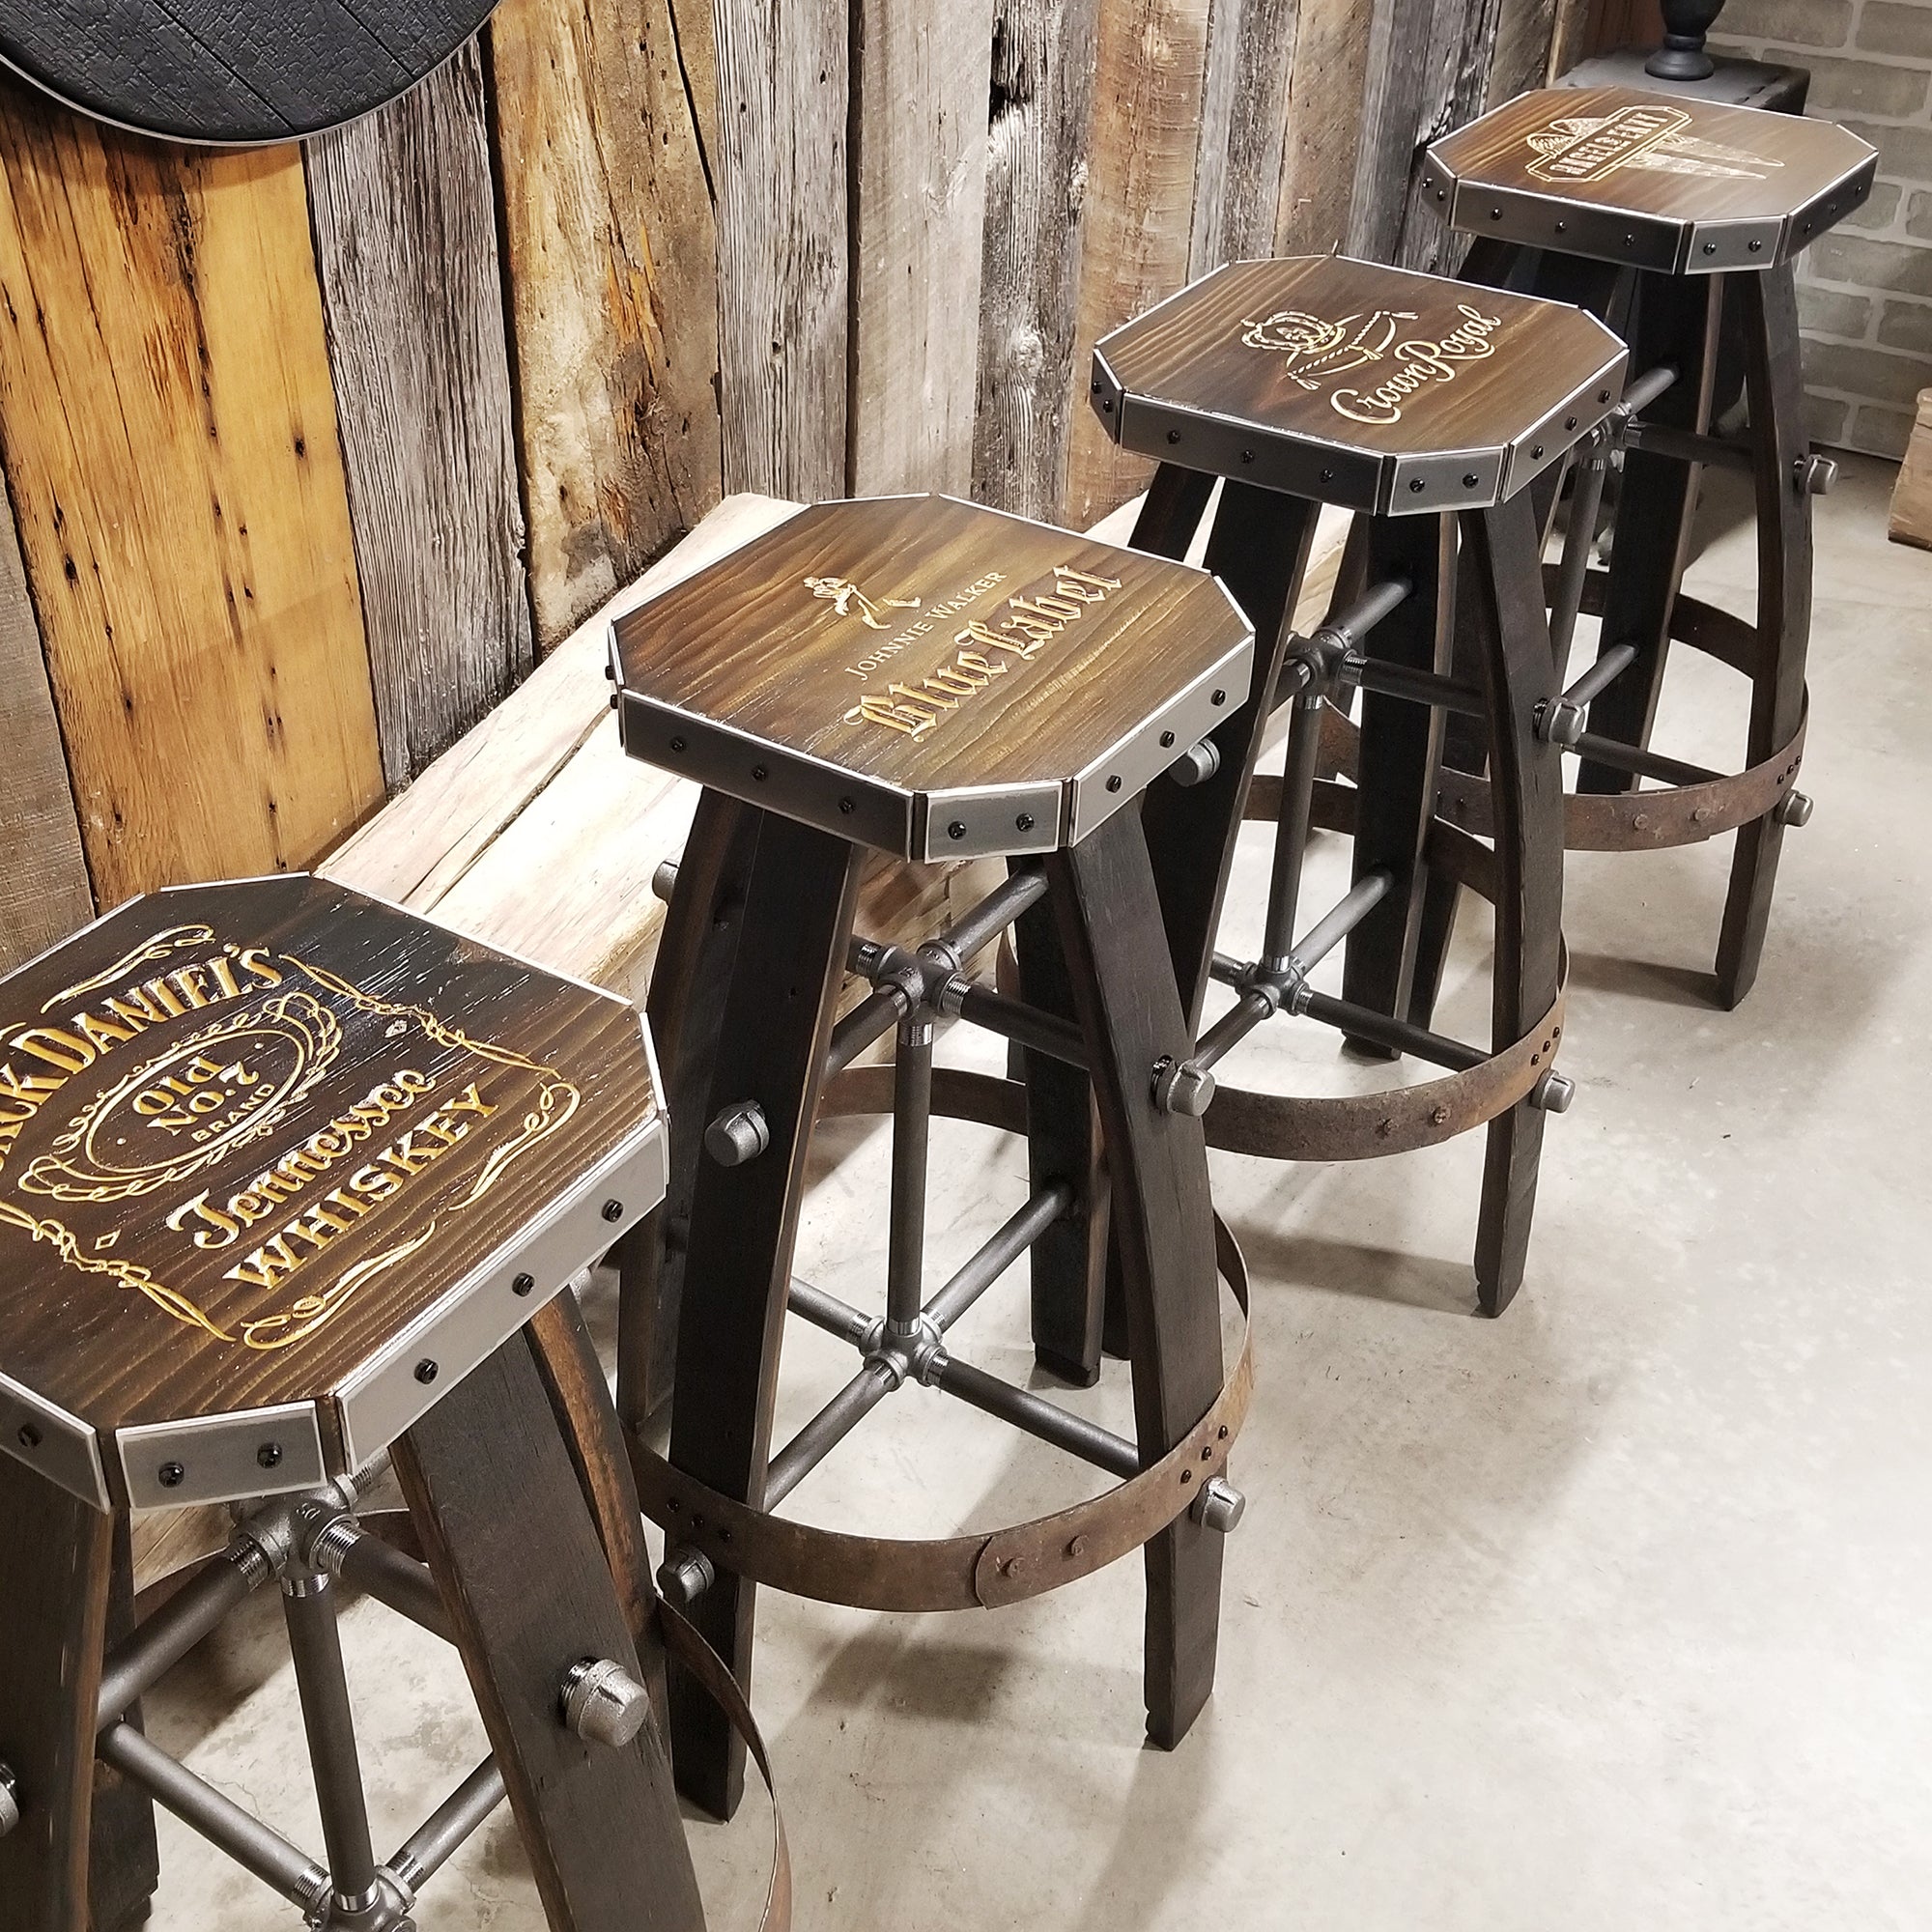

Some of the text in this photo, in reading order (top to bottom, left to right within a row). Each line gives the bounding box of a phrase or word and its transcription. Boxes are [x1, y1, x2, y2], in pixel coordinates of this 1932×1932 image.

[1330, 303, 1502, 424] Crown Royal
[843, 565, 1122, 743] Blue Label
[845, 571, 1008, 681] JOHNNIE WALKER
[9, 943, 283, 1075] DANIEL'S
[132, 1056, 226, 1115] Old
[191, 1083, 275, 1142] BRAND
[165, 1069, 437, 1249] Tennessee
[222, 1082, 498, 1290] WHISKEY
